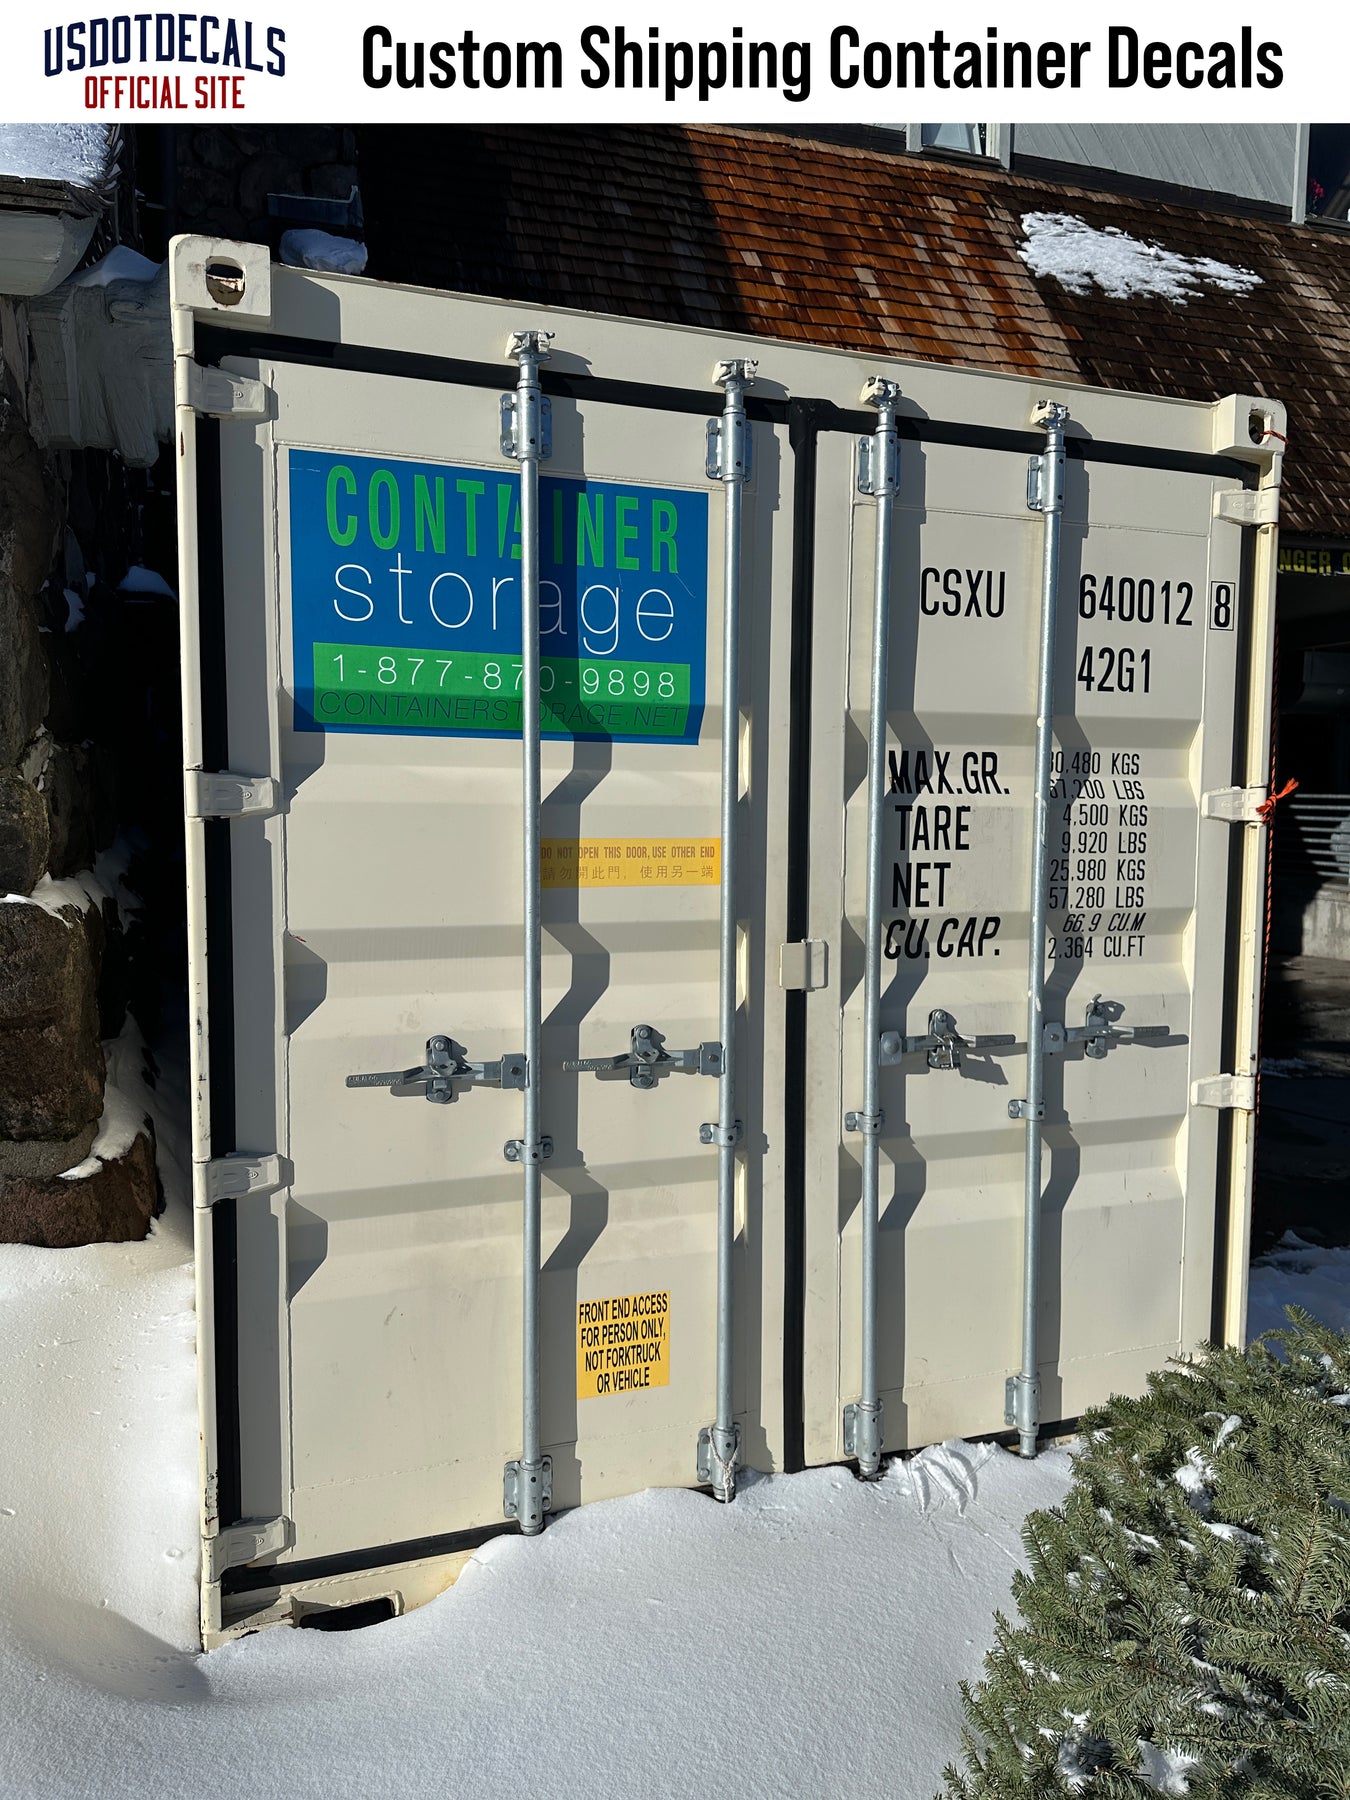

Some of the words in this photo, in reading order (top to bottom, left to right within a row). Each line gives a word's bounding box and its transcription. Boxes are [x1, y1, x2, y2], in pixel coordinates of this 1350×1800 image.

[326, 465, 679, 574] CONTAINER
[333, 552, 675, 655] storage
[920, 567, 1006, 618] CSXU
[1078, 574, 1194, 626] 640012
[1213, 584, 1232, 628] 8
[333, 654, 675, 698] 1-877-870-9898
[1077, 646, 1151, 693] 42G1
[888, 751, 1010, 794] MAX.GR.
[1111, 753, 1140, 775] KGS
[1113, 780, 1145, 800] LBS
[895, 805, 971, 851] TARE
[1119, 804, 1148, 826] KGS
[1118, 831, 1147, 854] LBS
[541, 847, 552, 859] DO
[557, 847, 573, 859] NOT
[578, 846, 599, 859] OPEN
[604, 846, 621, 859] THIS
[671, 846, 696, 858] OTHER
[700, 846, 715, 858] END
[892, 862, 951, 908] NET
[1117, 859, 1146, 881] KGS
[1115, 886, 1145, 908] LBS
[884, 916, 1000, 960] CU.CAP.
[1107, 912, 1146, 931] CU.M
[1104, 935, 1145, 957] CU.FT
[579, 1300, 609, 1324] FRONT
[612, 1298, 630, 1319] END
[632, 1293, 668, 1317] ACCESS
[581, 1326, 599, 1348] FOR
[602, 1320, 639, 1345] PERSON
[641, 1317, 666, 1340] ONLY,
[585, 1350, 604, 1372] NOT
[606, 1341, 661, 1369] FORKTRUCK
[597, 1373, 610, 1393] OR
[612, 1367, 650, 1391] VEHICLE
